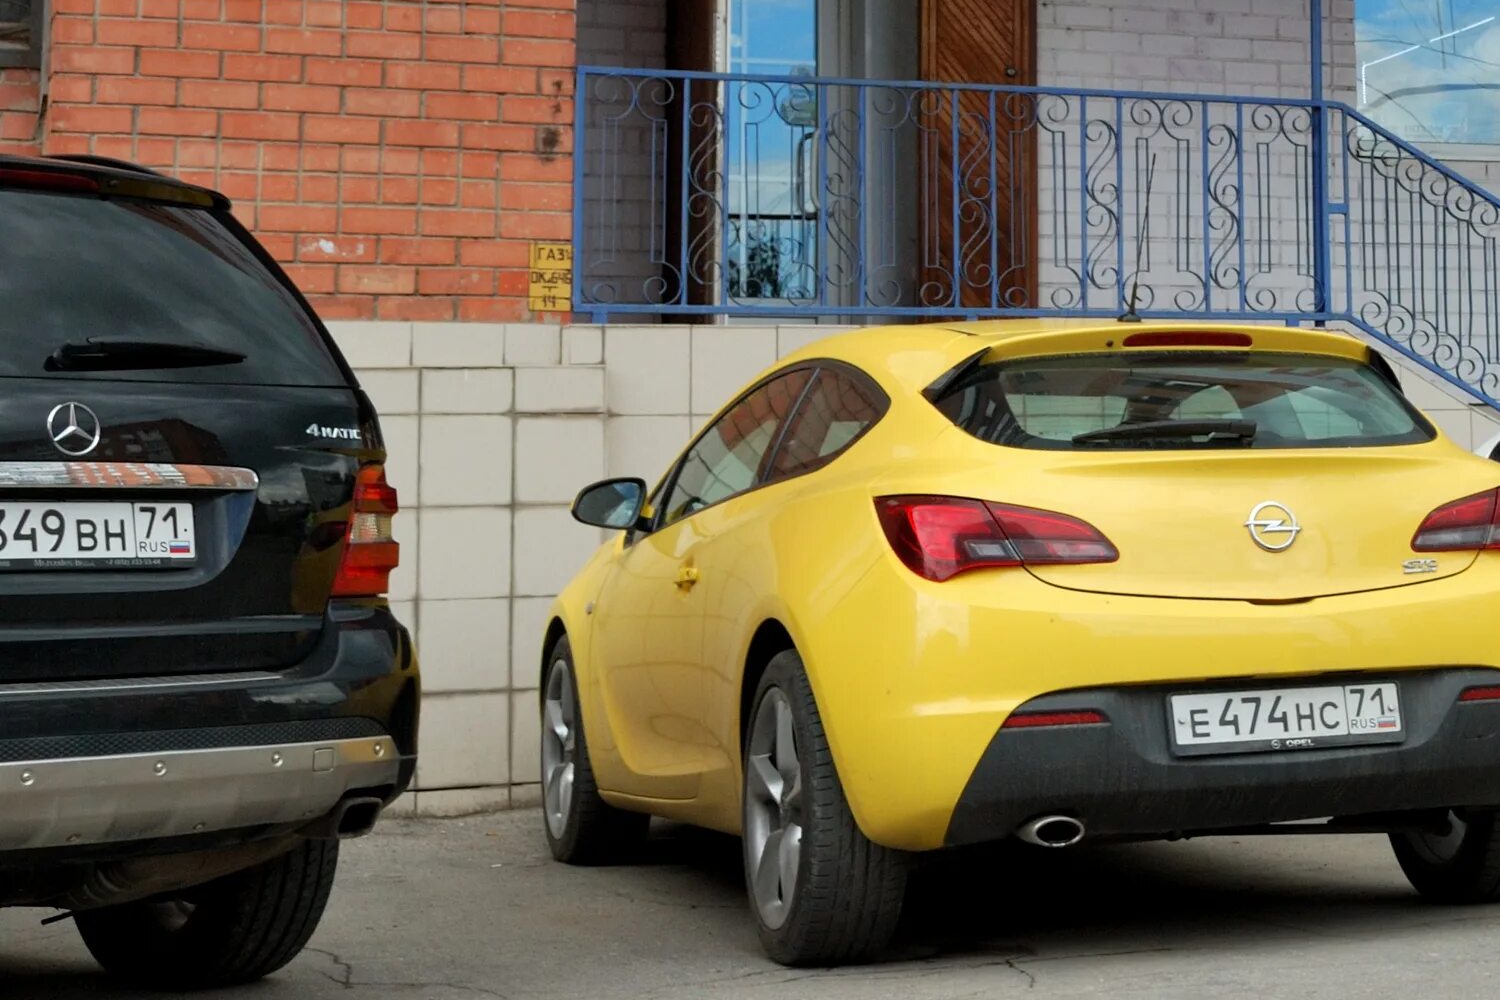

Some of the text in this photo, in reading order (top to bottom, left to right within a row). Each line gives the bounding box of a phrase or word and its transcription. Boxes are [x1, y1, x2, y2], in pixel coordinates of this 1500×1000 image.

[139, 541, 168, 552] RUS
[1351, 717, 1377, 729] RUS
[1286, 738, 1315, 748] OPEL
